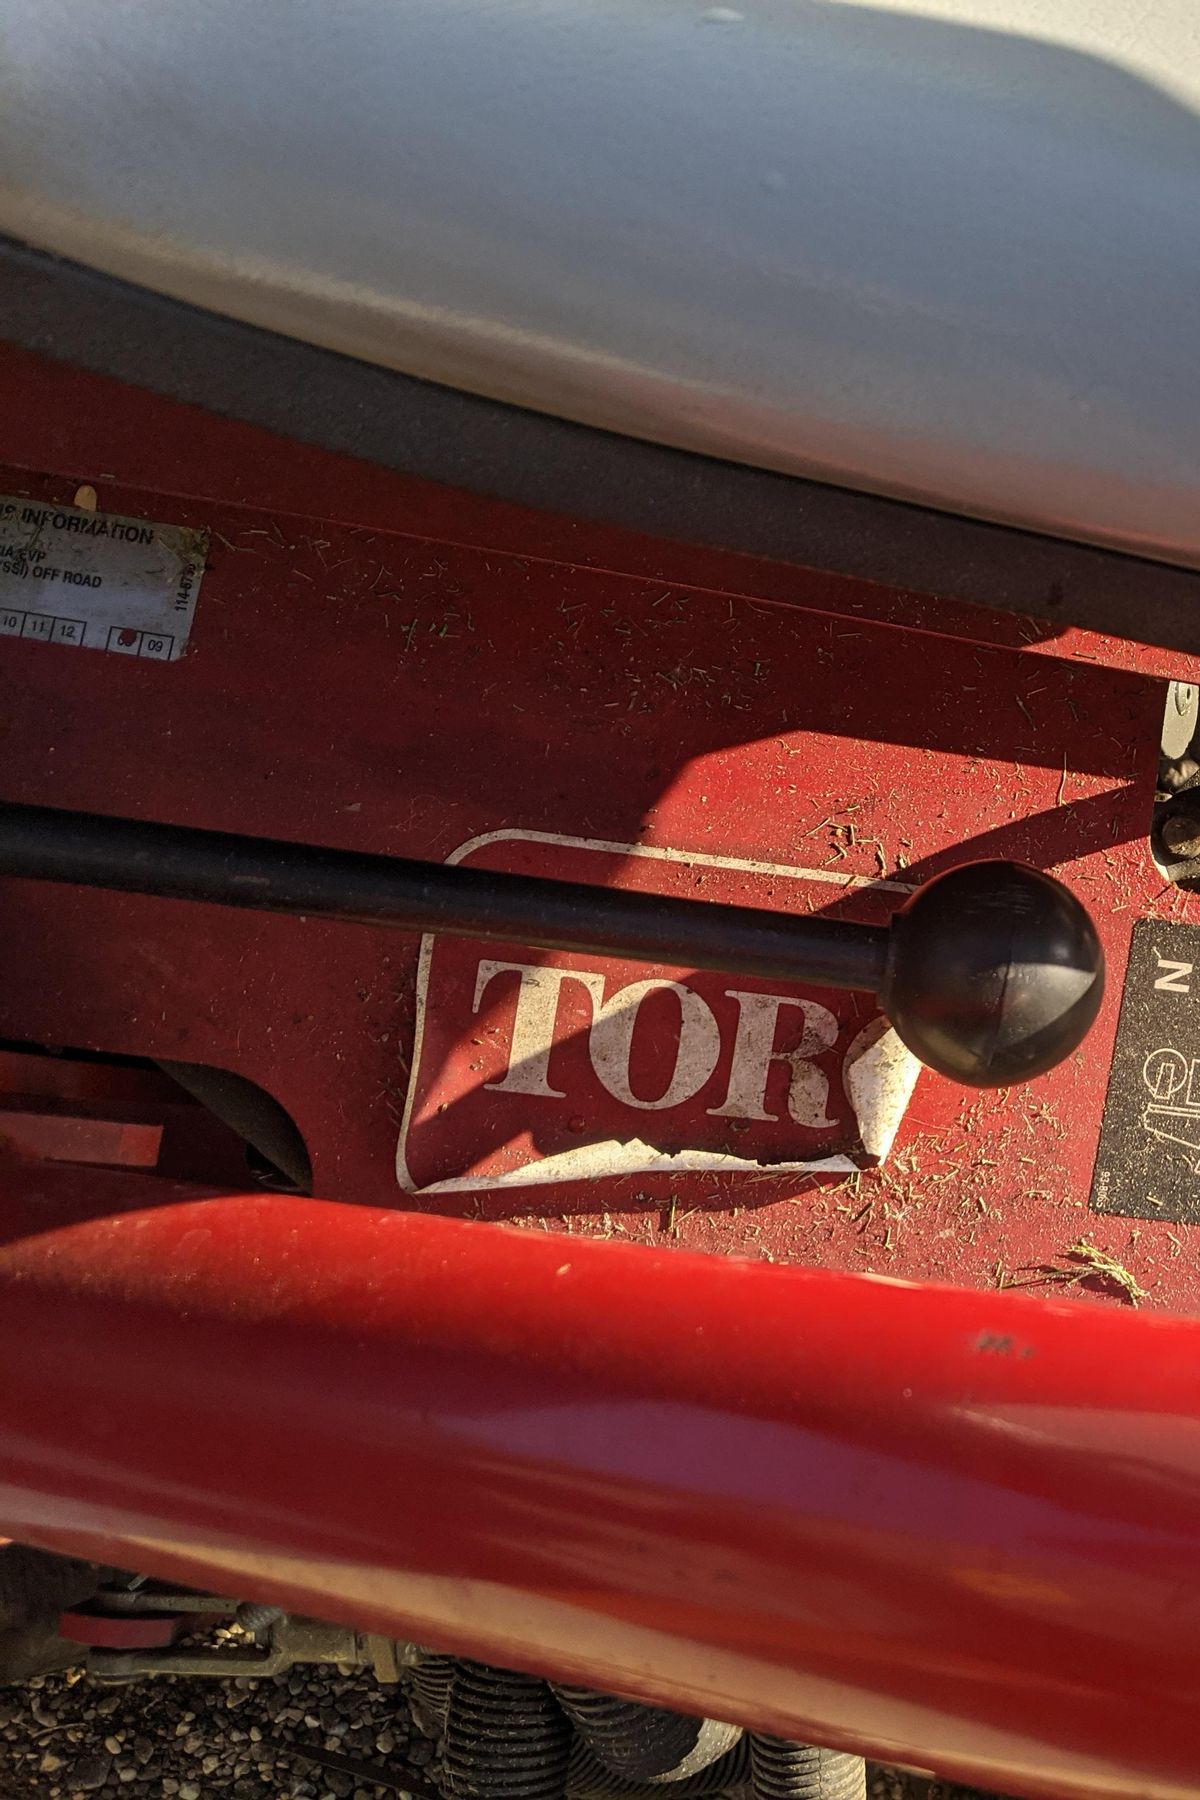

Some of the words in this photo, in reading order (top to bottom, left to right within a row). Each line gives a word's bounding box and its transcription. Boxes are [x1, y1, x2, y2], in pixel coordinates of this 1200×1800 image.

[21, 507, 154, 545] INFORMATION
[32, 566, 60, 581] OFF
[62, 570, 102, 588] ROAD
[3, 616, 17, 628] 10
[32, 620, 45, 633] 11
[60, 625, 75, 638] 12
[148, 639, 163, 652] 09
[1154, 958, 1194, 994] N
